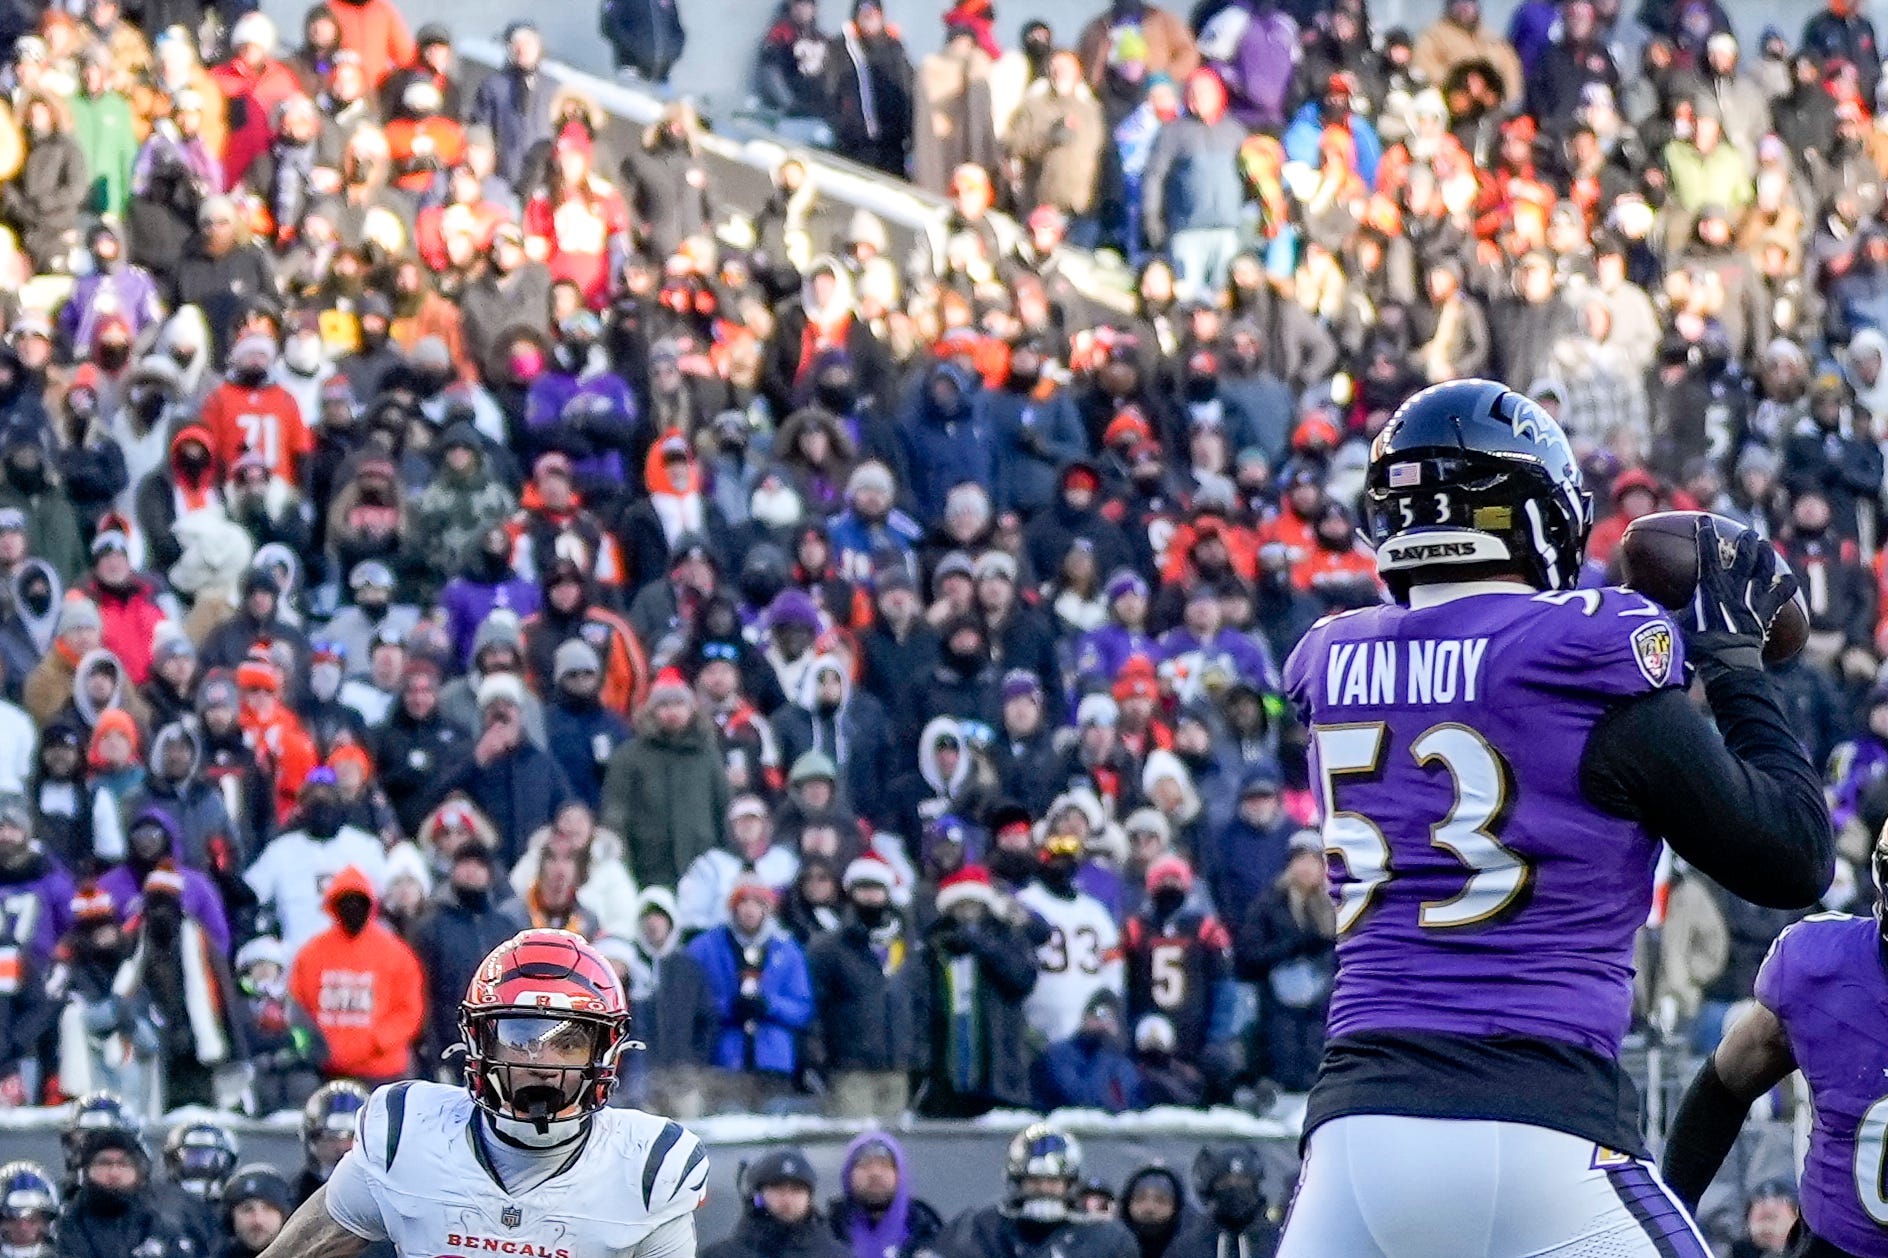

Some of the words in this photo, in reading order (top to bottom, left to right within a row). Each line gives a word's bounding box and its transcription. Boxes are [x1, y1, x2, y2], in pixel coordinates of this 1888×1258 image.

[1398, 492, 1451, 528] 53
[1387, 542, 1477, 562] RAVENS
[1326, 640, 1397, 706] VAN
[1407, 638, 1490, 704] NOY
[1314, 722, 1529, 934] 53
[1151, 945, 1186, 1008] 5
